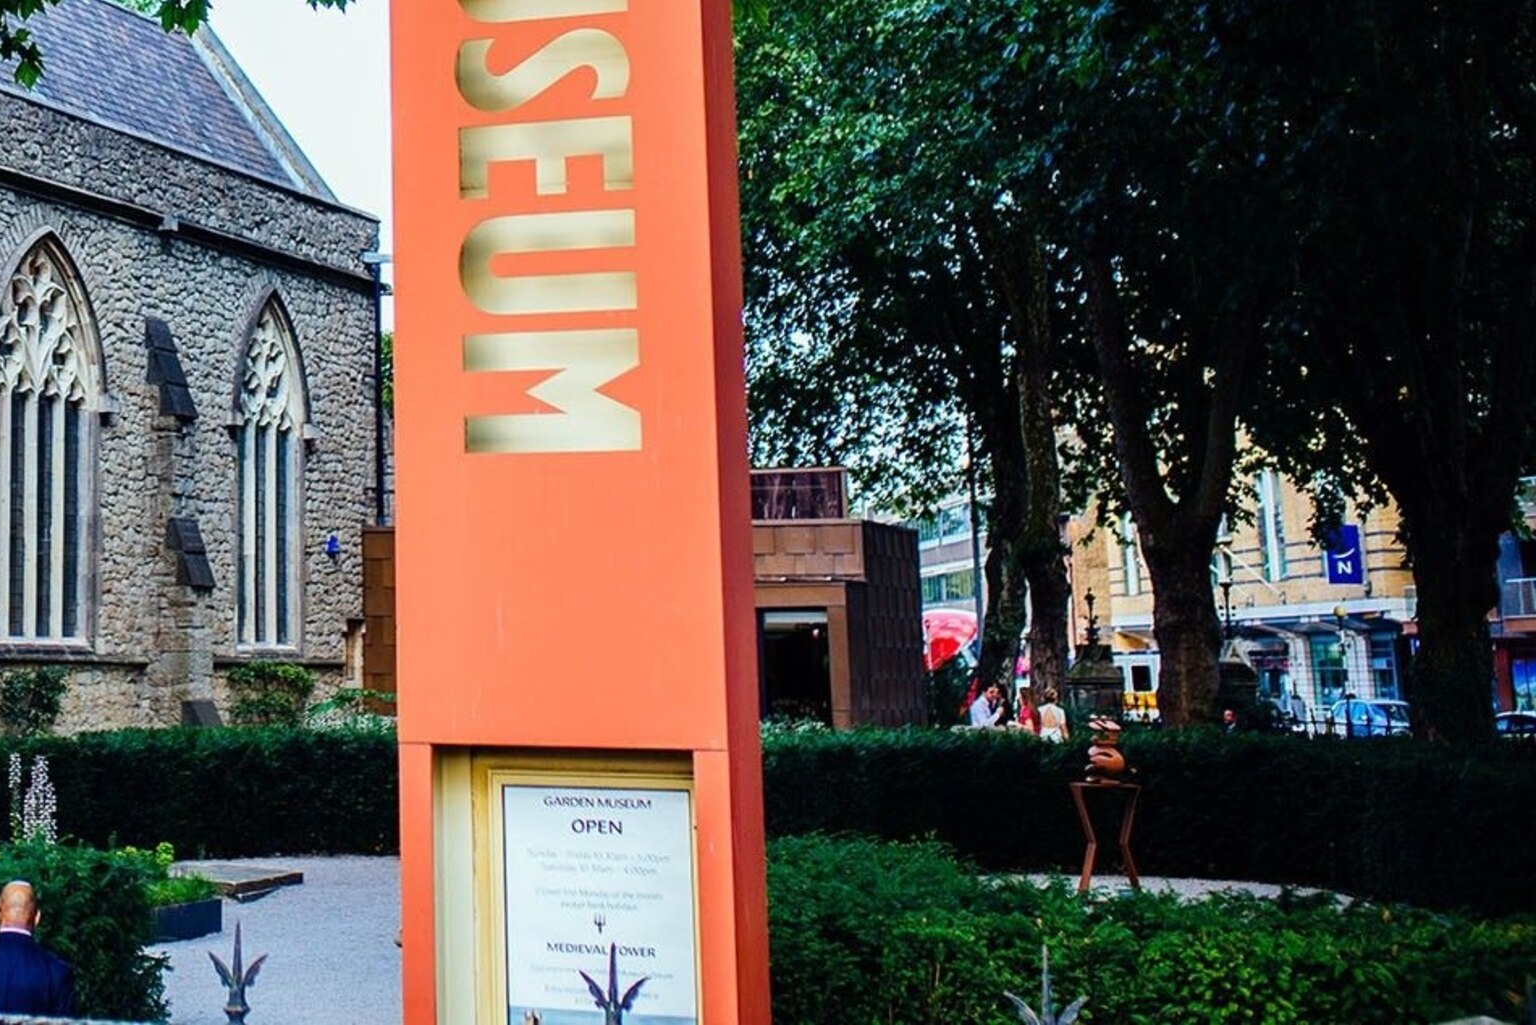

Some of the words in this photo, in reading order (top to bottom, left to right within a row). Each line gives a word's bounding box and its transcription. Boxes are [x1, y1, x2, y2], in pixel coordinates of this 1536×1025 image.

[1337, 560, 1352, 574] N
[543, 795, 595, 808] GARDEN
[597, 797, 652, 809] MUSEUM
[571, 819, 623, 835] OPEN
[546, 942, 609, 955] MEDIEVAL
